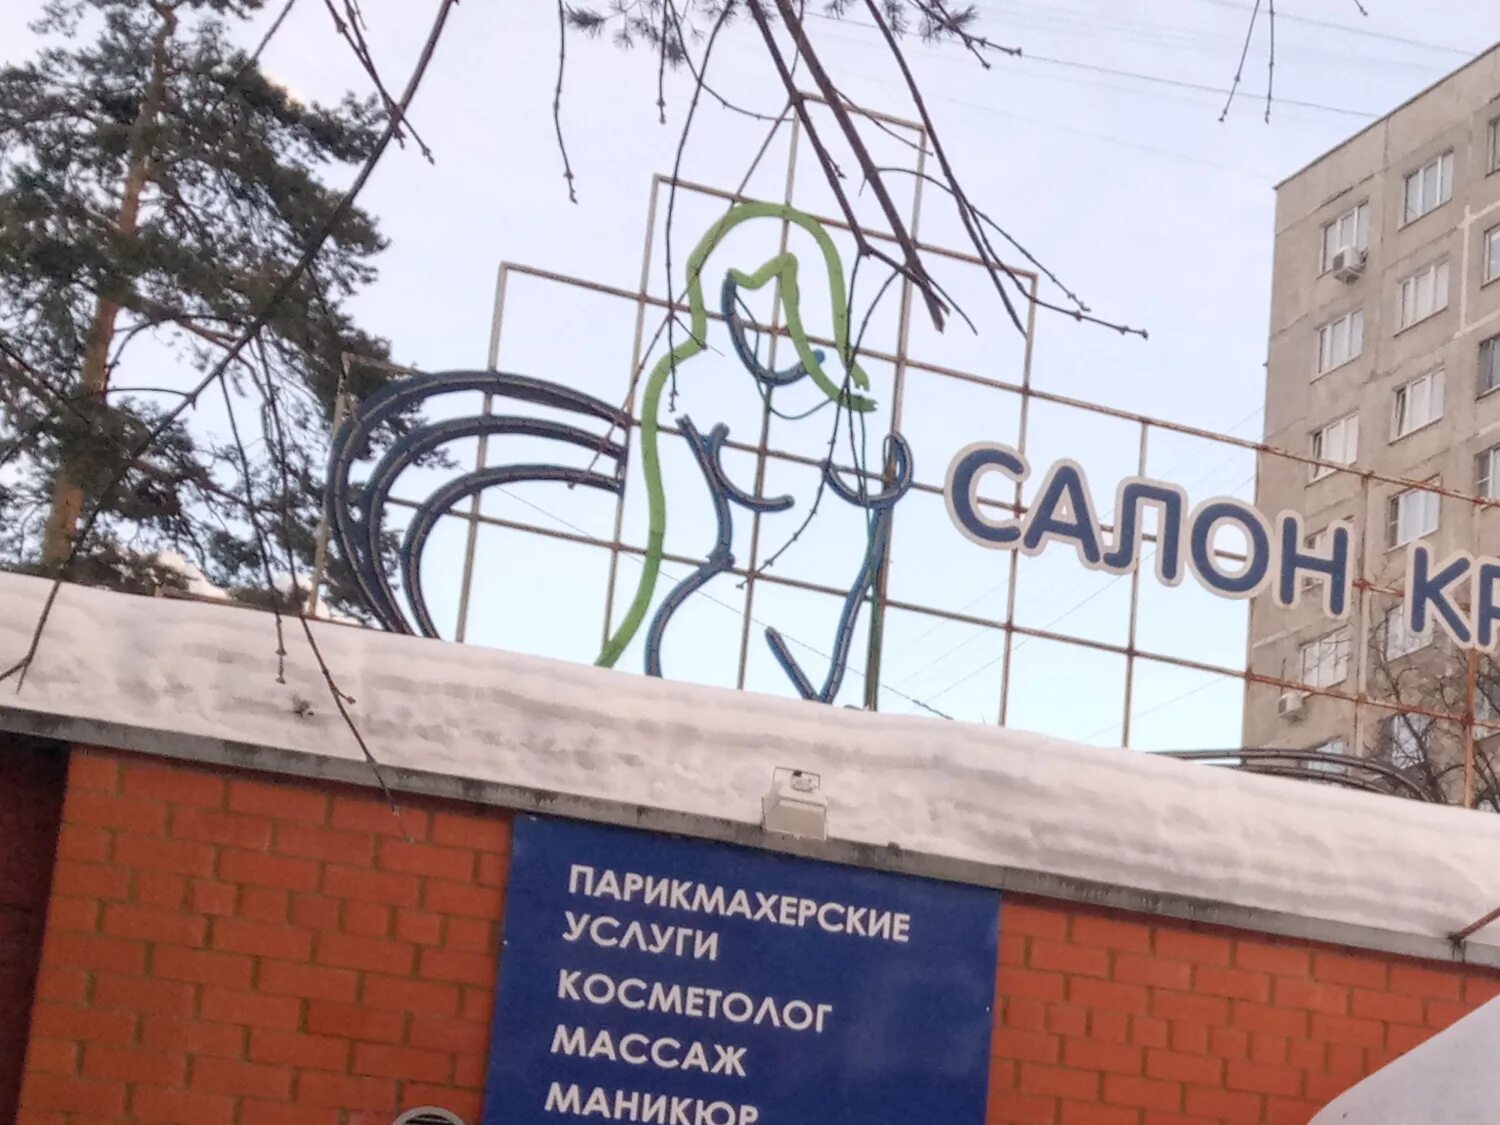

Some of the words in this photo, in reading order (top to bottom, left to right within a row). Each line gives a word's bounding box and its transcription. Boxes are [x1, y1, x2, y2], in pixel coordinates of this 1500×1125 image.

[946, 442, 1352, 617] САЛОН
[561, 910, 720, 961] УСЛУГИ
[567, 863, 912, 943] ПАРИКМАХЕРСКИЕ
[557, 968, 833, 1034] КОСМЕТОЛОГ
[550, 1024, 748, 1077] МАССАЖ
